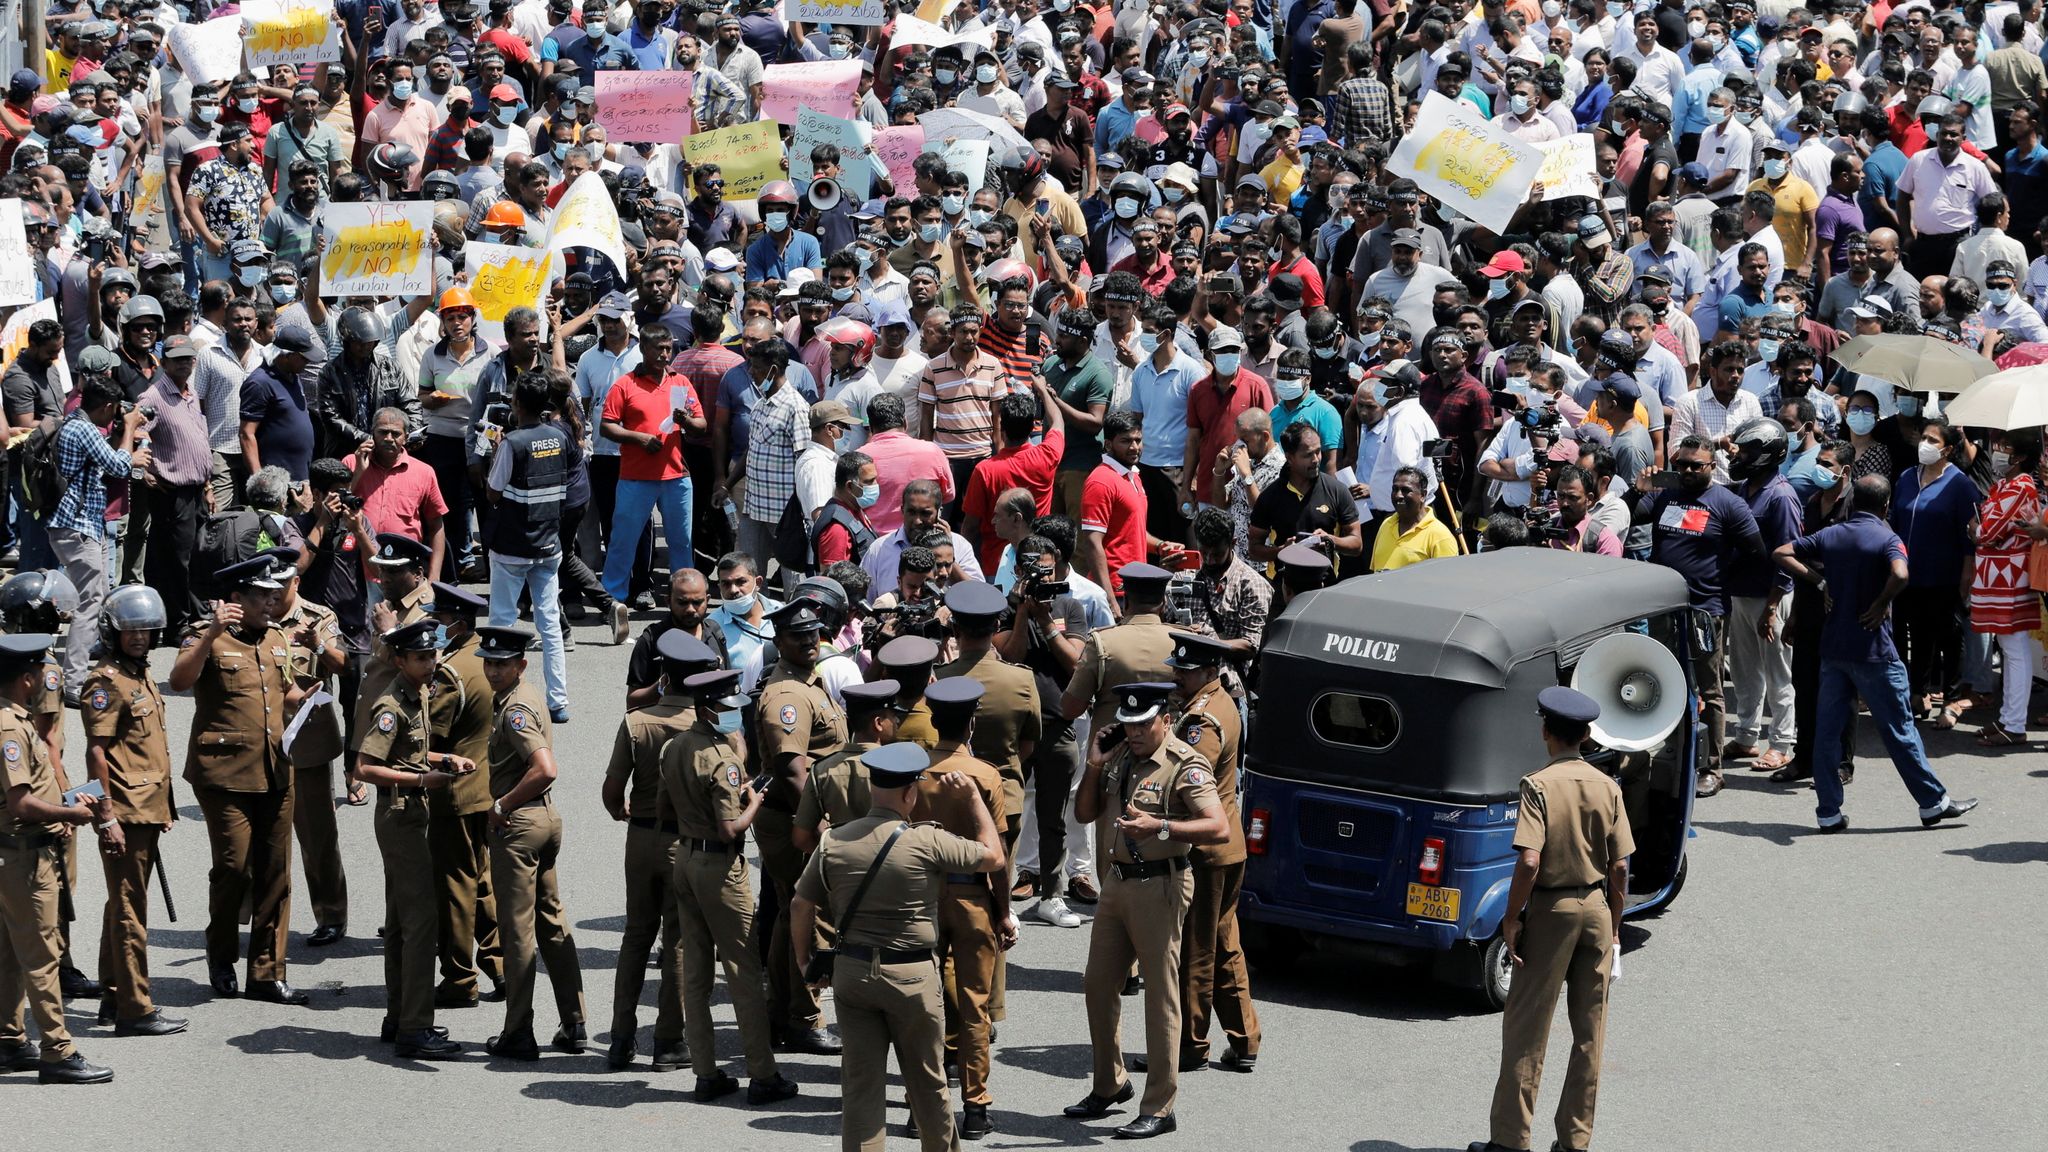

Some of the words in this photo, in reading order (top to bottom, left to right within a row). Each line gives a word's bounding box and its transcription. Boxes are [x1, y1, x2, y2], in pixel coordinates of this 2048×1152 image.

[280, 33, 304, 48] NO
[255, 52, 266, 65] to
[272, 50, 307, 63] unfair
[316, 49, 333, 59] tax
[1647, 113, 1659, 122] TAX
[1155, 150, 1166, 162] 3
[366, 203, 407, 228] YES
[669, 207, 680, 217] TAX
[1133, 223, 1155, 232] UNFAIR
[328, 235, 342, 254] to
[350, 232, 410, 253] reasonable
[363, 257, 392, 273] NO
[330, 280, 343, 292] to
[351, 276, 391, 292] unfair
[402, 273, 425, 292] tax
[1865, 303, 1878, 314] TAX
[955, 315, 977, 324] UNFAIR
[1069, 327, 1082, 337] TAX
[1387, 329, 1399, 338] TAX
[1778, 329, 1791, 338] TAX
[1948, 331, 1959, 341] TAX
[1454, 338, 1464, 349] TAX
[1605, 358, 1618, 368] TAX
[531, 438, 560, 451] PRESS
[1322, 633, 1400, 662] POLICE
[1409, 894, 1421, 905] WP
[1425, 888, 1450, 903] ABV
[1421, 903, 1450, 919] 2968
